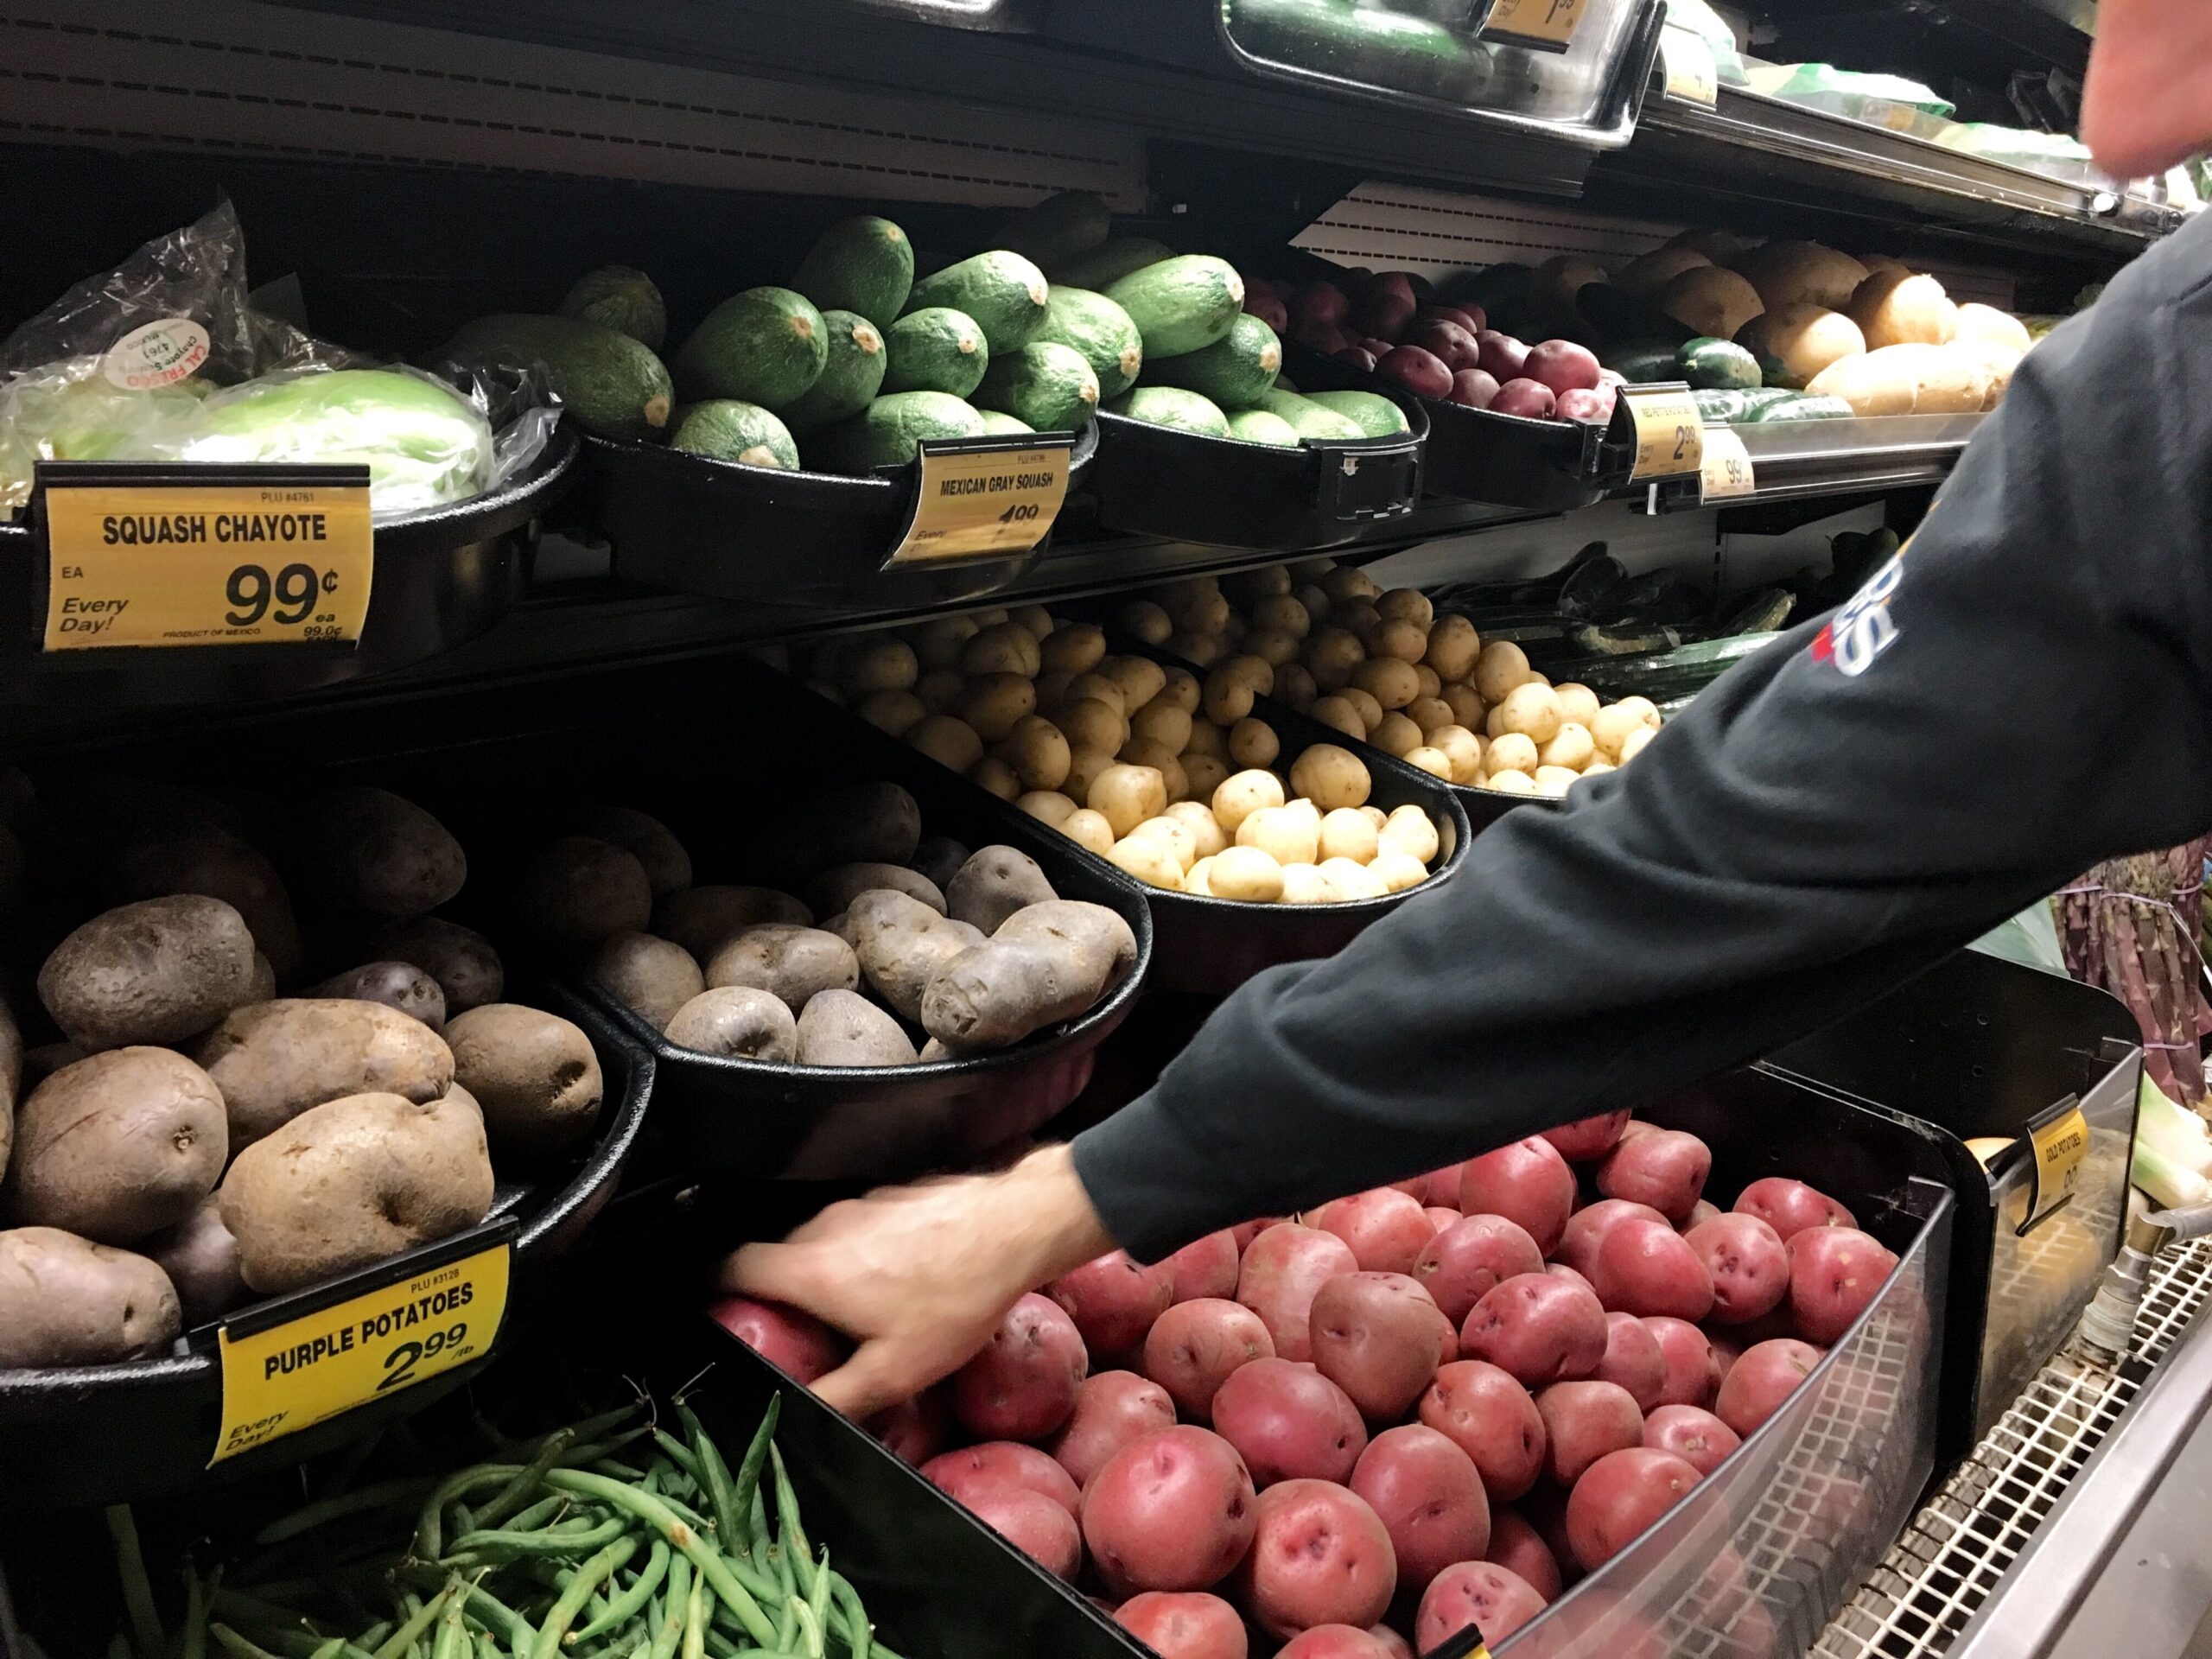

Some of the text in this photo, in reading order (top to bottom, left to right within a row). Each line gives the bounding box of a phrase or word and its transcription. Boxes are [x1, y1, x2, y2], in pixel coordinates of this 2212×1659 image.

[166, 335, 197, 365] Chayote
[184, 345, 207, 367] CAL
[126, 364, 188, 387] FRESCO
[940, 472, 1053, 496] MEXICAN GRAY SQUASH
[261, 493, 315, 503] PLU #4761
[103, 513, 327, 546] SQUASH CHAYOTE
[61, 566, 84, 579] EA
[61, 597, 130, 615] Every
[60, 615, 114, 635] Day!
[315, 613, 335, 623] ea
[162, 629, 209, 639] PRODUCT
[2045, 1131, 2081, 1163] GOLD POTATOES
[410, 1278, 430, 1294] PLU
[264, 1281, 474, 1381] PURPLE POTATOES
[450, 1344, 475, 1362] /lb
[229, 1410, 289, 1440] Every
[225, 1426, 276, 1452] Day!
